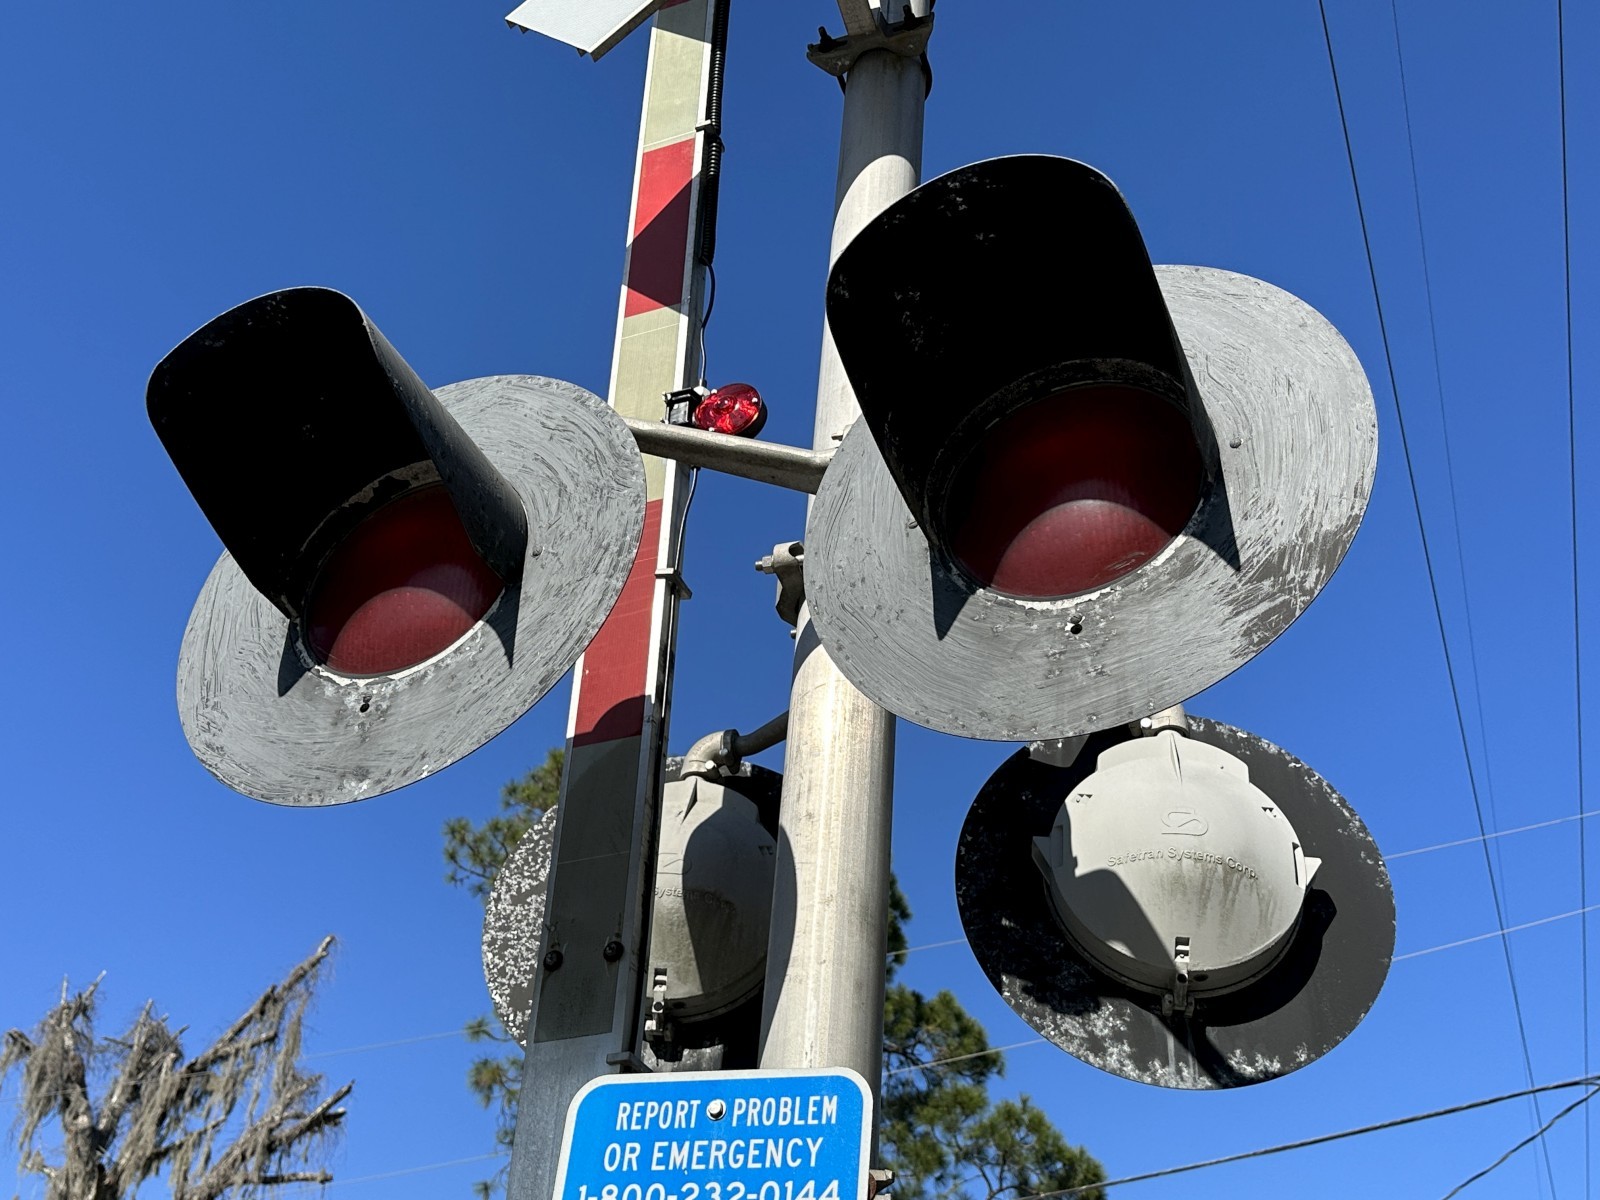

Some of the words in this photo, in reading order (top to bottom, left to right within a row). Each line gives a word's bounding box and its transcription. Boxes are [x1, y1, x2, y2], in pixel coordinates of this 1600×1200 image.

[1107, 849, 1164, 867] Safetran
[1167, 847, 1223, 865] Systems
[1226, 857, 1259, 880] Corp.
[615, 1100, 701, 1131] REPORT
[732, 1095, 838, 1127] PROBLEM
[603, 1142, 641, 1171] OR
[651, 1137, 823, 1170] EMERGENCY
